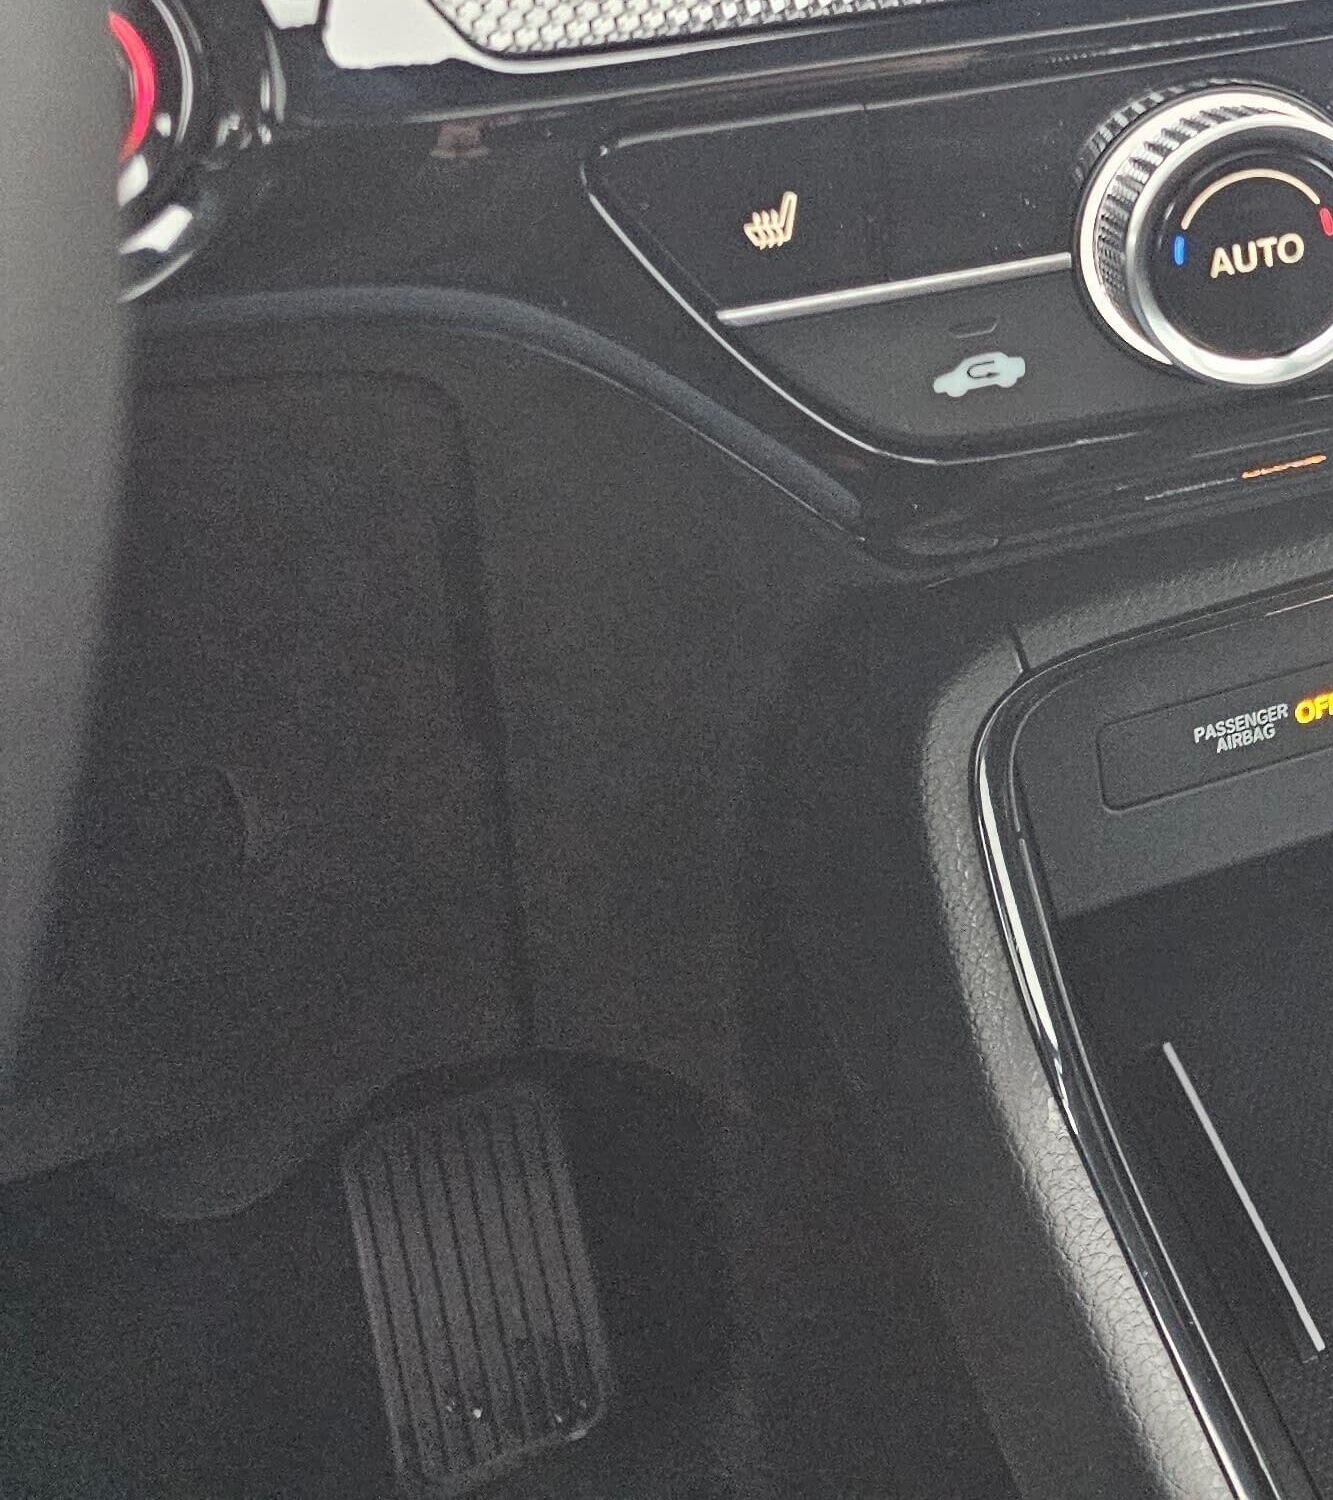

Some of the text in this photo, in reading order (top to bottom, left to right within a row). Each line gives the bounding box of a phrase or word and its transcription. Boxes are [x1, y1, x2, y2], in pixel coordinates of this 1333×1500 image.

[1209, 232, 1305, 279] AUTO
[1193, 703, 1289, 743] PASSENGER
[1216, 724, 1277, 753] AIRBAG
